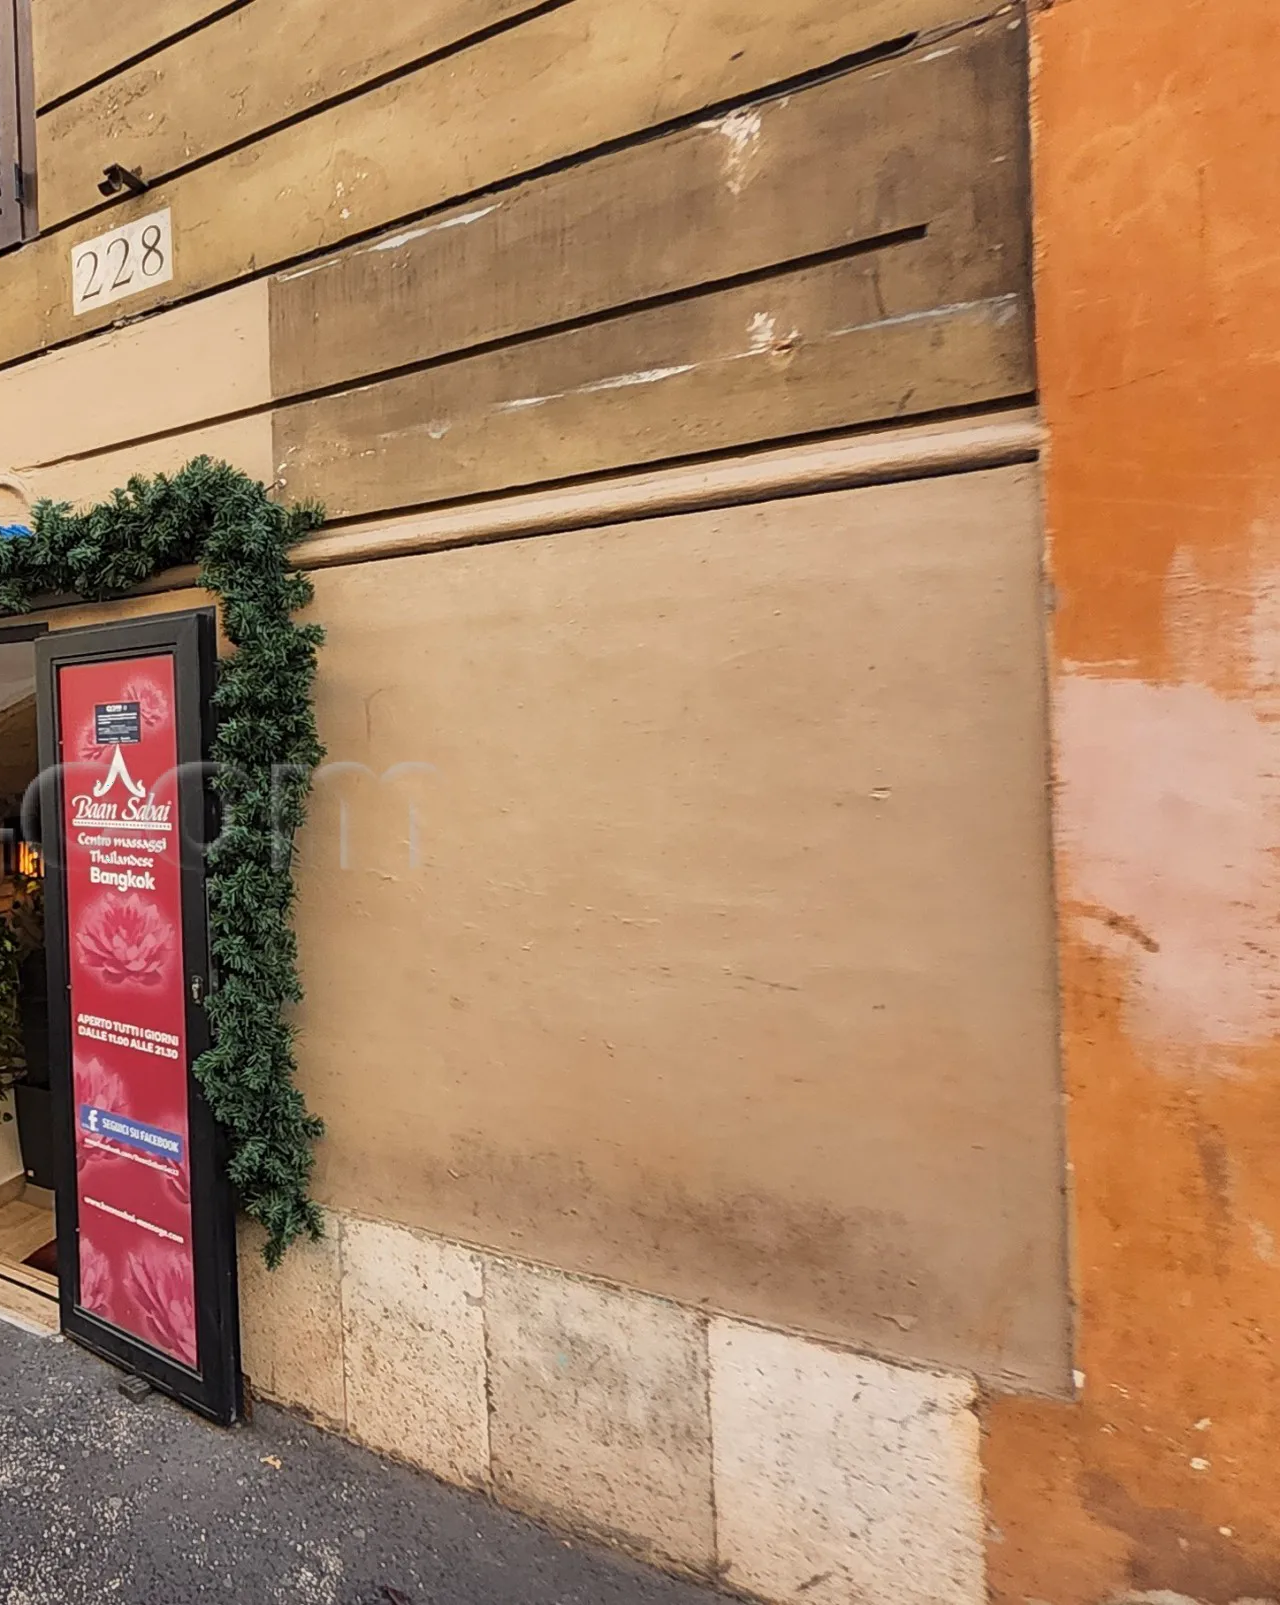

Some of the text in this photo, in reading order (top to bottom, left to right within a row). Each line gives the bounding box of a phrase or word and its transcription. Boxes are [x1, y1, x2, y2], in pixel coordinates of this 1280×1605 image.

[76, 224, 165, 302] 228
[72, 793, 172, 821] Baan Sabai
[77, 832, 167, 853] Centro massaggi
[89, 849, 154, 868] Thailandese
[90, 866, 156, 892] Bangkok
[77, 1013, 179, 1047] APERTO TUTTI I GIORNI
[78, 1025, 179, 1060] DALLE 11.00 ALLE 21.30
[101, 1117, 130, 1136] SEGUICI
[129, 1126, 140, 1140] SU
[140, 1130, 180, 1153] FACEBOOK
